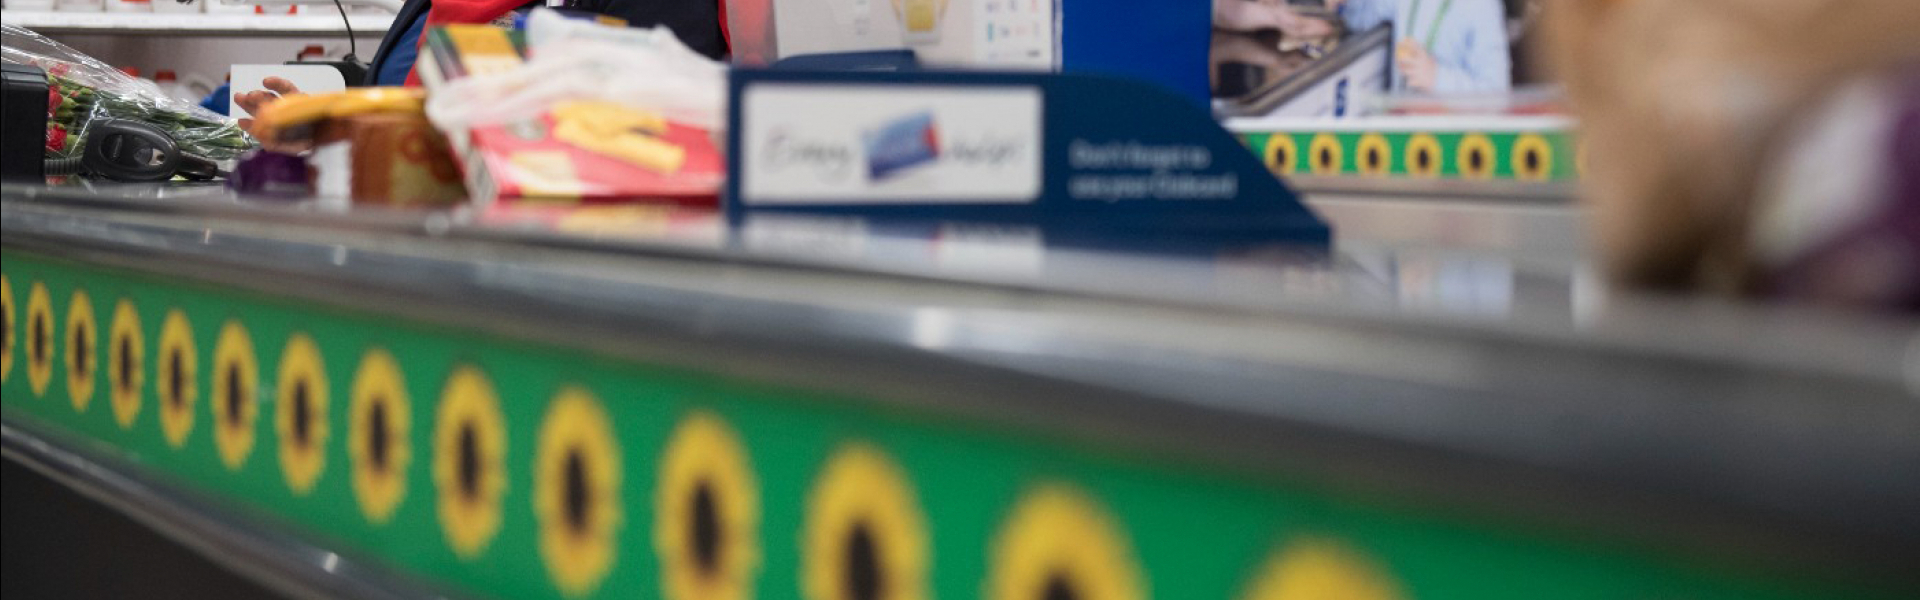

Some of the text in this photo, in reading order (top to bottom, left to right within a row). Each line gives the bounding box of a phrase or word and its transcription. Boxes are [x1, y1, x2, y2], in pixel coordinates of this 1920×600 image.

[1069, 140, 1211, 173] Don't forget to
[1101, 176, 1147, 202] your
